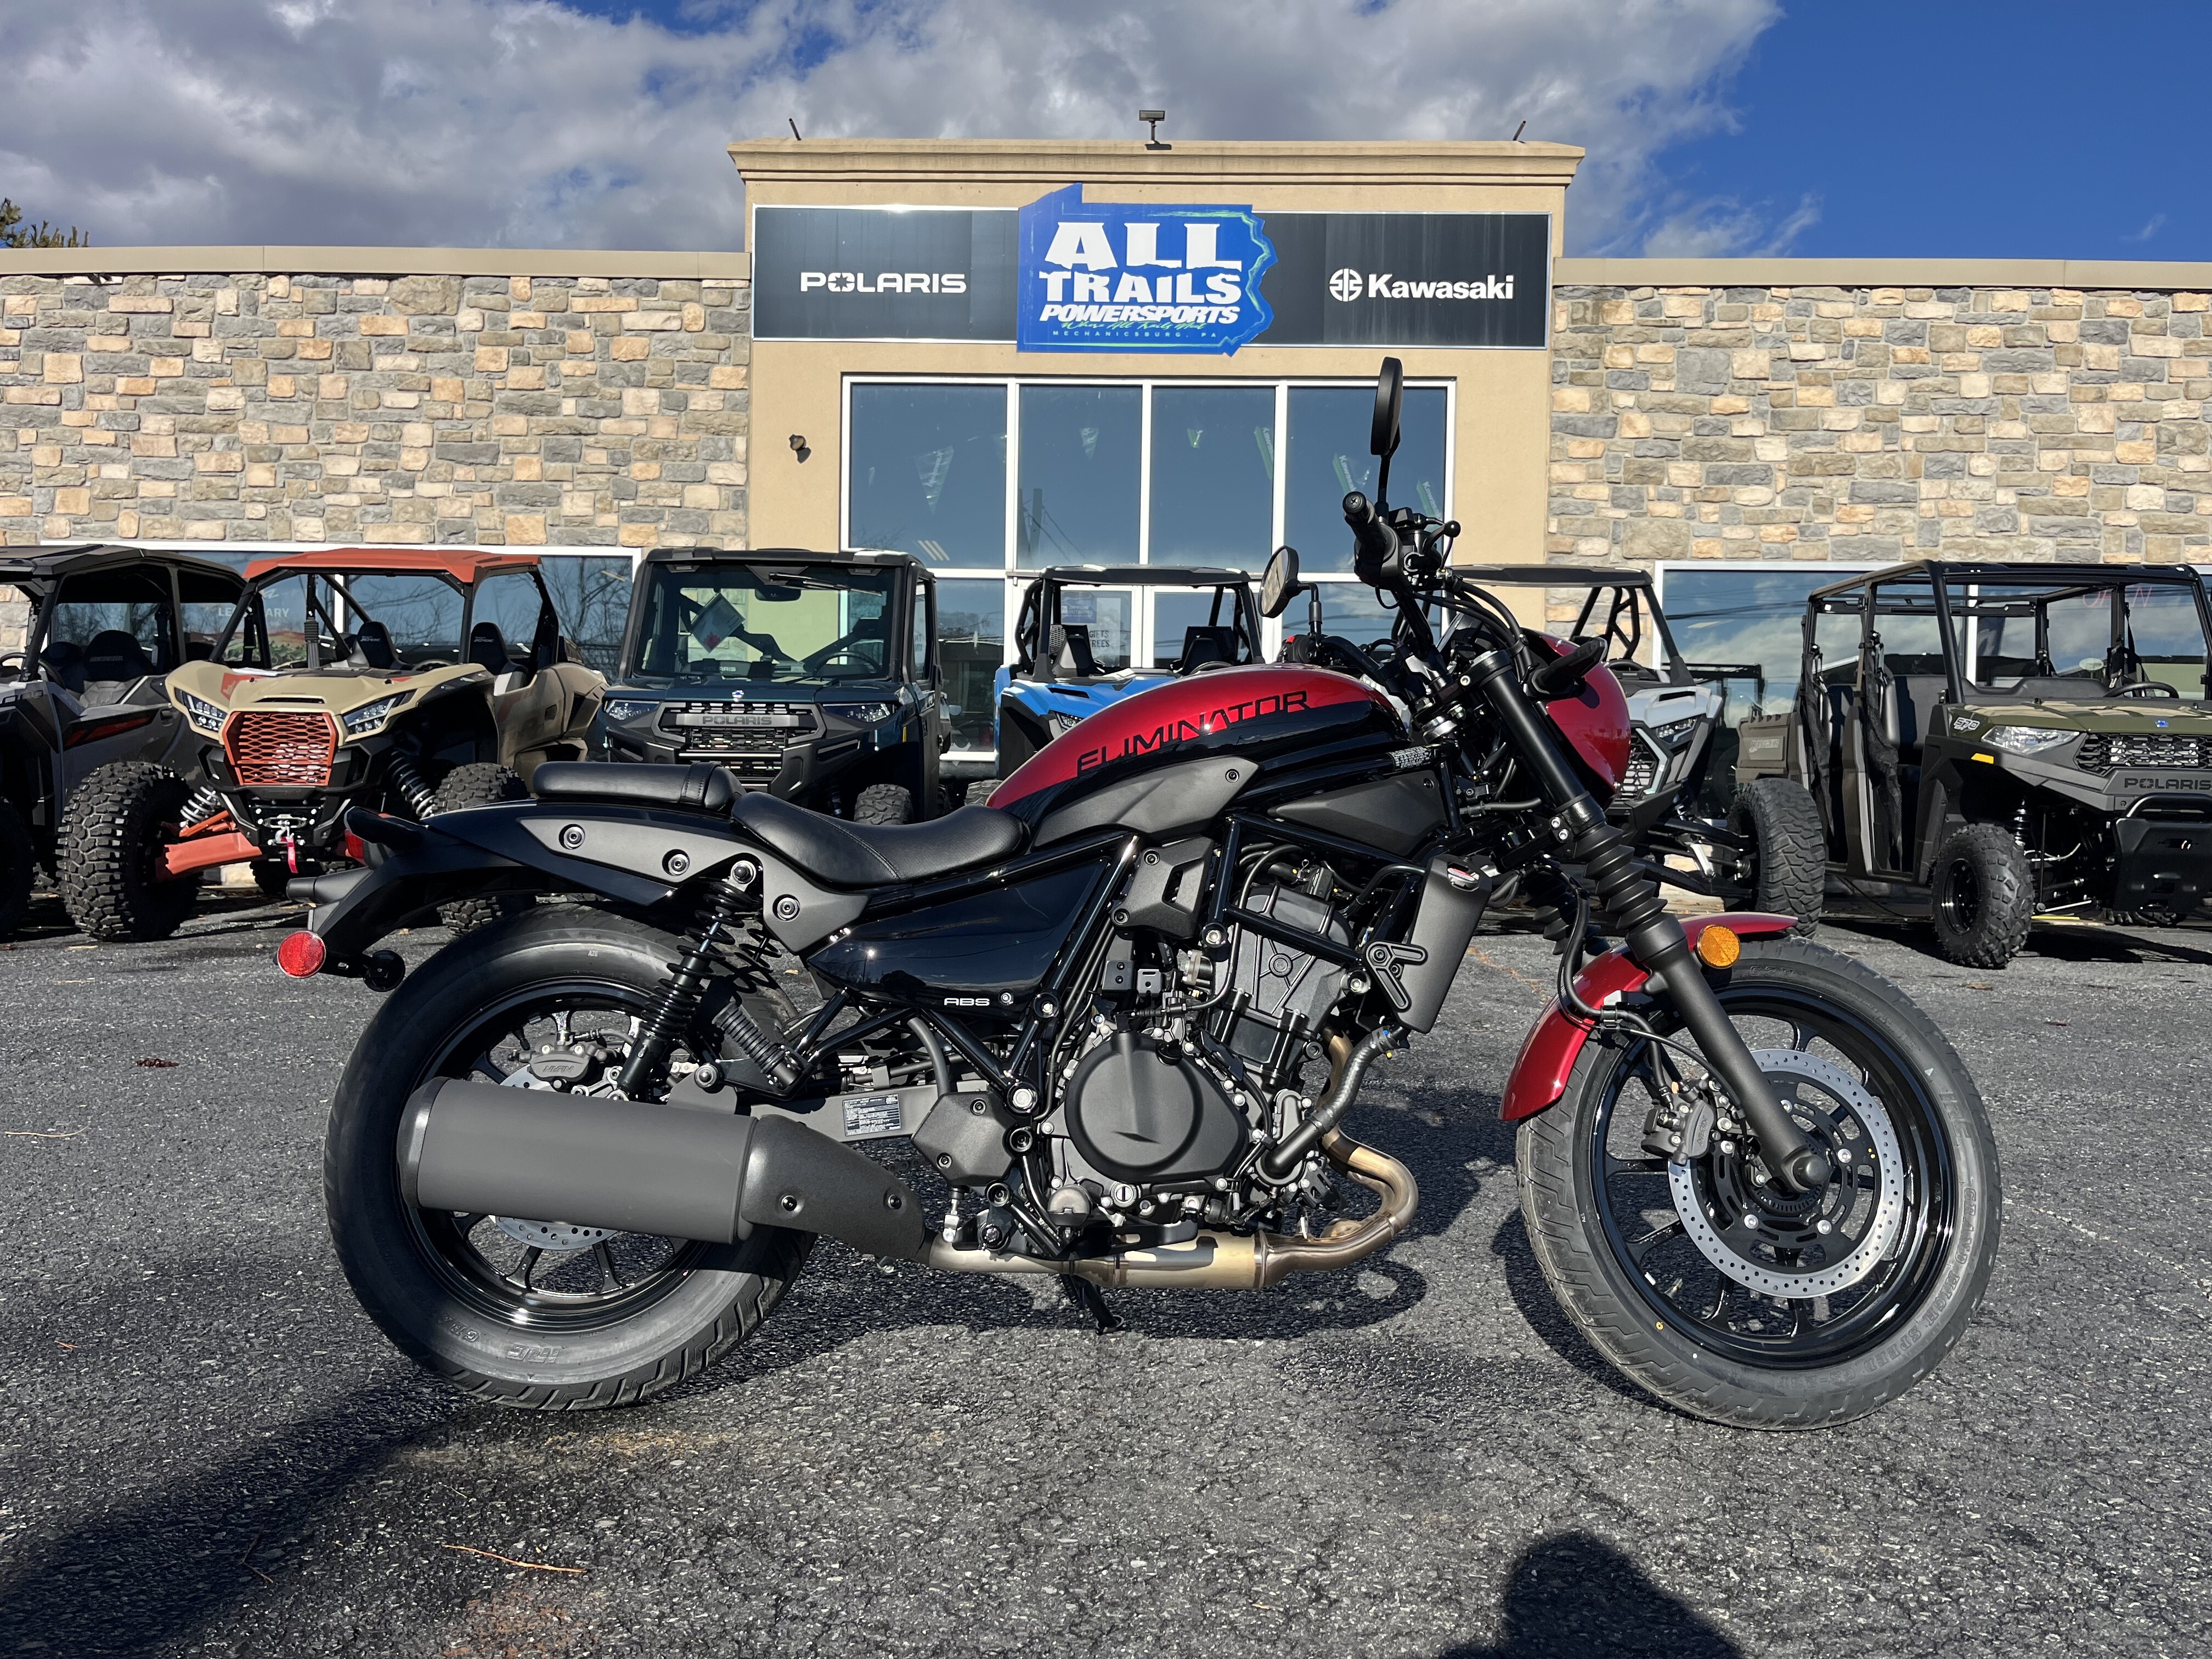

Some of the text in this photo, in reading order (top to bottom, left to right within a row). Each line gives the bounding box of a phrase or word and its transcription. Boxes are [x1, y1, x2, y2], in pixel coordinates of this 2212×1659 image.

[1045, 222, 1242, 272] ALL
[800, 272, 967, 293] POLARIS
[1039, 271, 1242, 304] TRAILS
[1368, 273, 1514, 299] Kawasaki
[1039, 304, 1240, 324] POWERSPORTS
[1061, 320, 1105, 329] Where
[1106, 320, 1133, 330] All
[1136, 320, 1173, 330] Trails
[1339, 455, 1357, 492] Kawasak
[218, 607, 289, 618] LEARY
[703, 716, 772, 725] POLARIS
[1954, 717, 1980, 730] 570
[1077, 691, 1311, 776] ELIMINATOR
[2124, 778, 2211, 790] POLARIS
